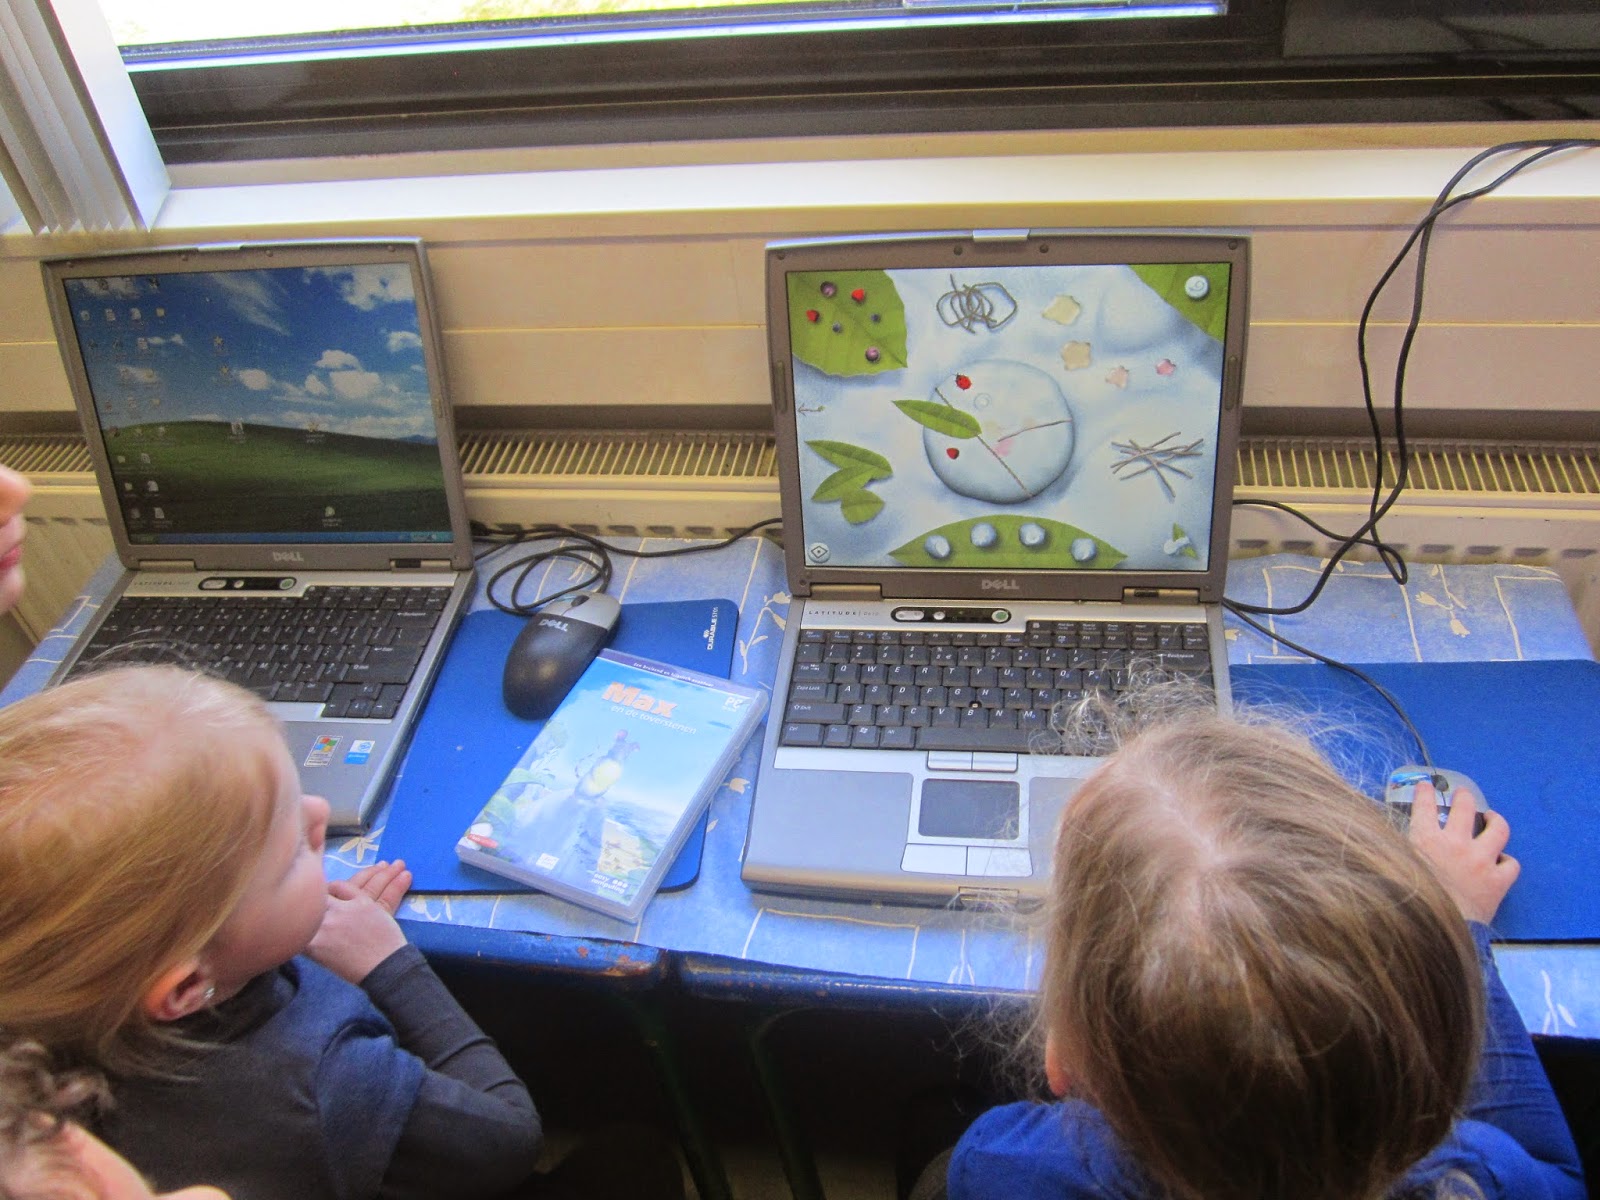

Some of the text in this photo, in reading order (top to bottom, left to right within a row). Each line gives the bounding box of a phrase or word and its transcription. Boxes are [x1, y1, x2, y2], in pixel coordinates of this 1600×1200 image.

[272, 551, 304, 562] DELL
[981, 579, 1020, 590] DELL
[539, 619, 568, 632] DELL
[707, 618, 718, 650] DURABLE
[602, 681, 678, 719] Max
[724, 696, 743, 709] PC
[611, 704, 697, 735] en de toverstenen
[593, 873, 610, 884] easy
[591, 878, 625, 894] computing
